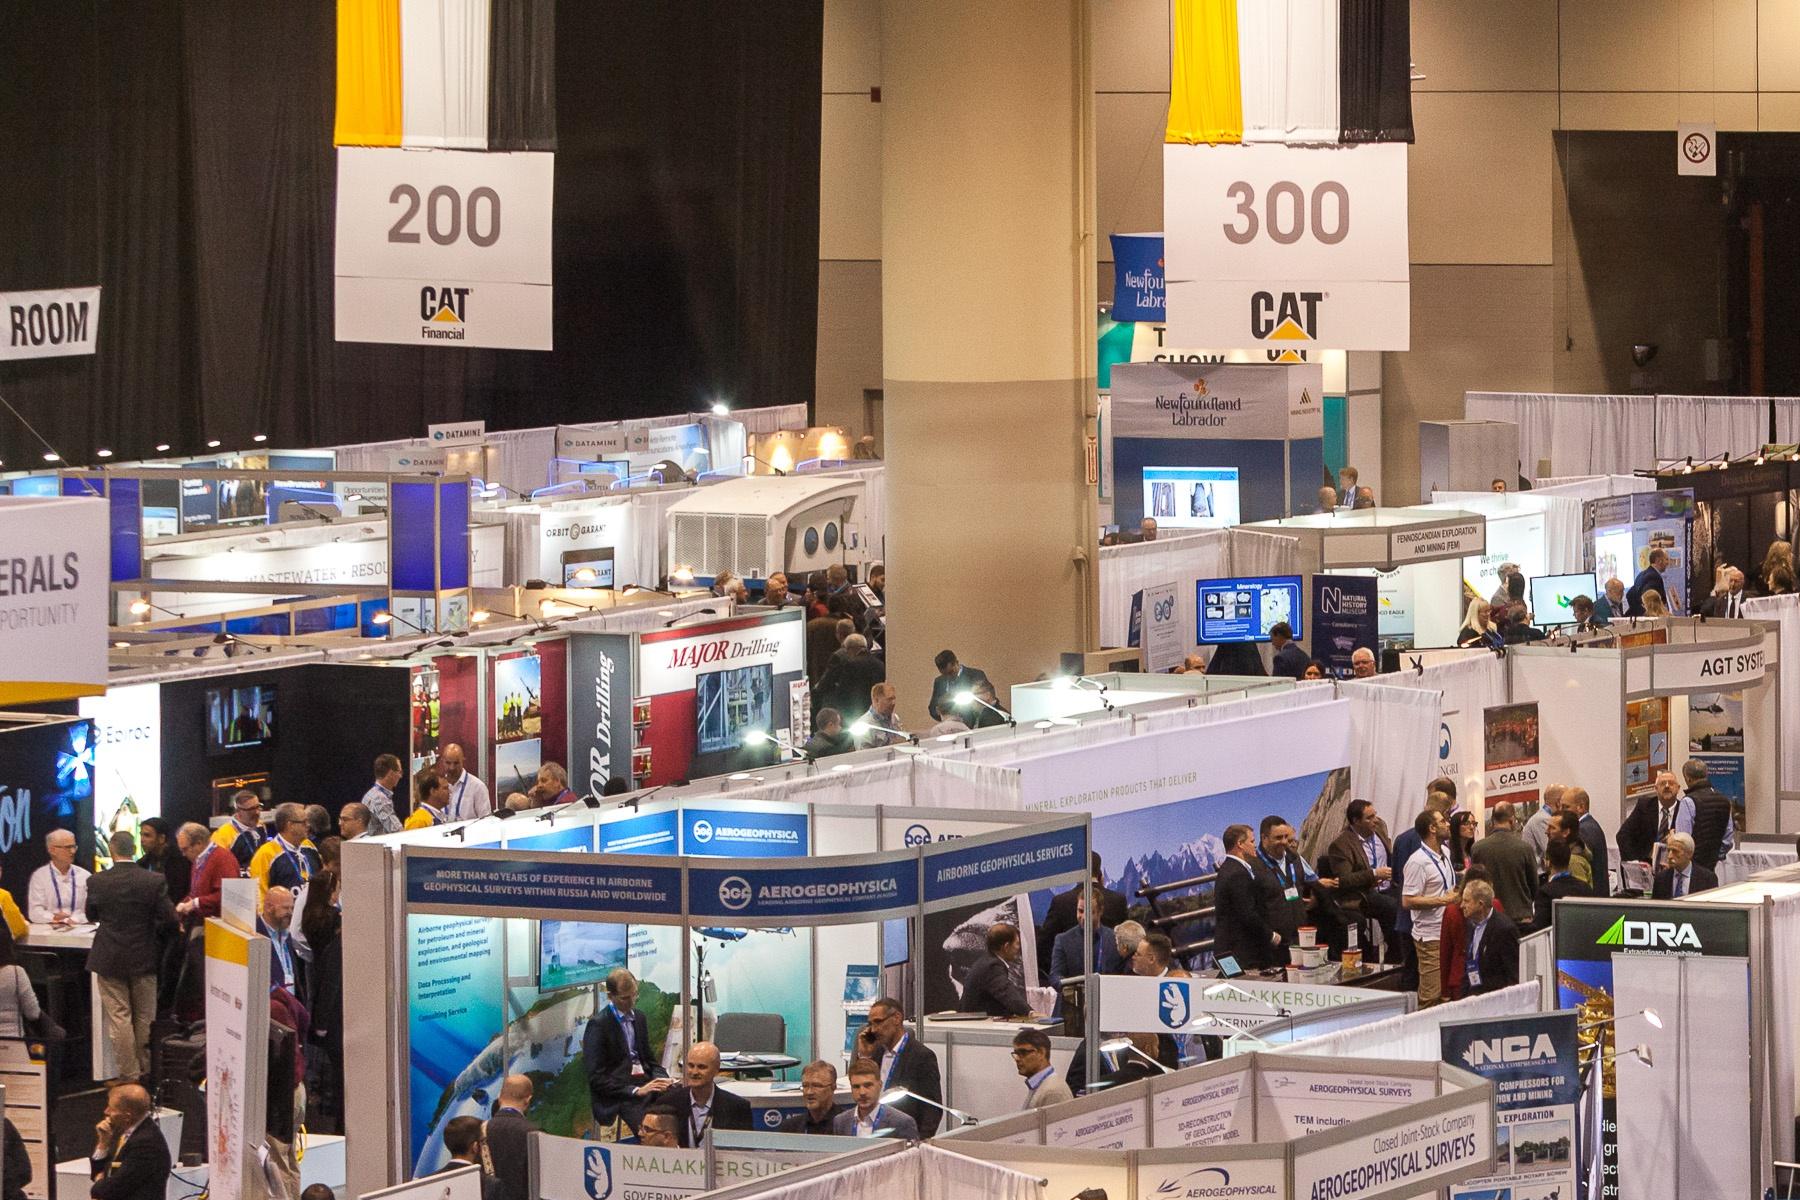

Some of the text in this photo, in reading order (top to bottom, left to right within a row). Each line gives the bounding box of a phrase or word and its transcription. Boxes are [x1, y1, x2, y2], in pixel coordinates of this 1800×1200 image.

[388, 183, 502, 249] 200
[1222, 180, 1350, 246] 300
[420, 285, 468, 324] CAT
[10, 300, 89, 348] ROOM
[1250, 290, 1324, 344] CAT
[421, 326, 466, 342] Financial
[1155, 393, 1242, 417] Newfoundland
[1171, 411, 1228, 430] Labrador
[445, 428, 481, 441] DATAMINE
[575, 438, 618, 448] DATAMINE
[546, 527, 570, 538] ORBIT
[1396, 526, 1478, 544] FENNOSCANDIAN EXPLORATION
[1414, 544, 1426, 554] AND
[1426, 542, 1446, 554] MINING
[666, 637, 780, 670] MAJOR Drilling
[596, 651, 618, 749] Drilling
[1499, 769, 1539, 786] CABO
[1024, 771, 1198, 814] MINERAL EXPLORATION PRODUCTS THAT DELIVER
[714, 826, 799, 841] AEROGEOPHYSICA
[936, 842, 1074, 883] AIRBORNE GEOPHYSICAL SERVICES
[435, 869, 654, 889] MORE THAN 40 YEARS OF EXPERIENCE IN AIRBORNE
[758, 877, 898, 899] AEROGEOPHYSICA
[422, 881, 668, 902] GEOPHYSICAL SURVEYS WITHIN RUSSIA AND WORLDWIDE
[1623, 920, 1703, 950] DRA
[1473, 1032, 1558, 1066] NCA
[1220, 1085, 1240, 1099] SURVEYS
[1309, 1085, 1412, 1098] AEROGEOPHYSICAL SURVEYS
[1498, 1075, 1566, 1093] COMPRESSORS FOR
[1512, 1089, 1554, 1103] AND MINING
[1503, 1110, 1555, 1125] EXPLORATION
[1184, 1123, 1226, 1142] OF GEOLOGICAL
[1221, 1130, 1240, 1143] MODEL
[1372, 1106, 1477, 1156] Closed Joint-Stock Company
[1424, 1136, 1477, 1176] SURVEYS
[1185, 1184, 1278, 1199] AEROGEOPHYSICAL
